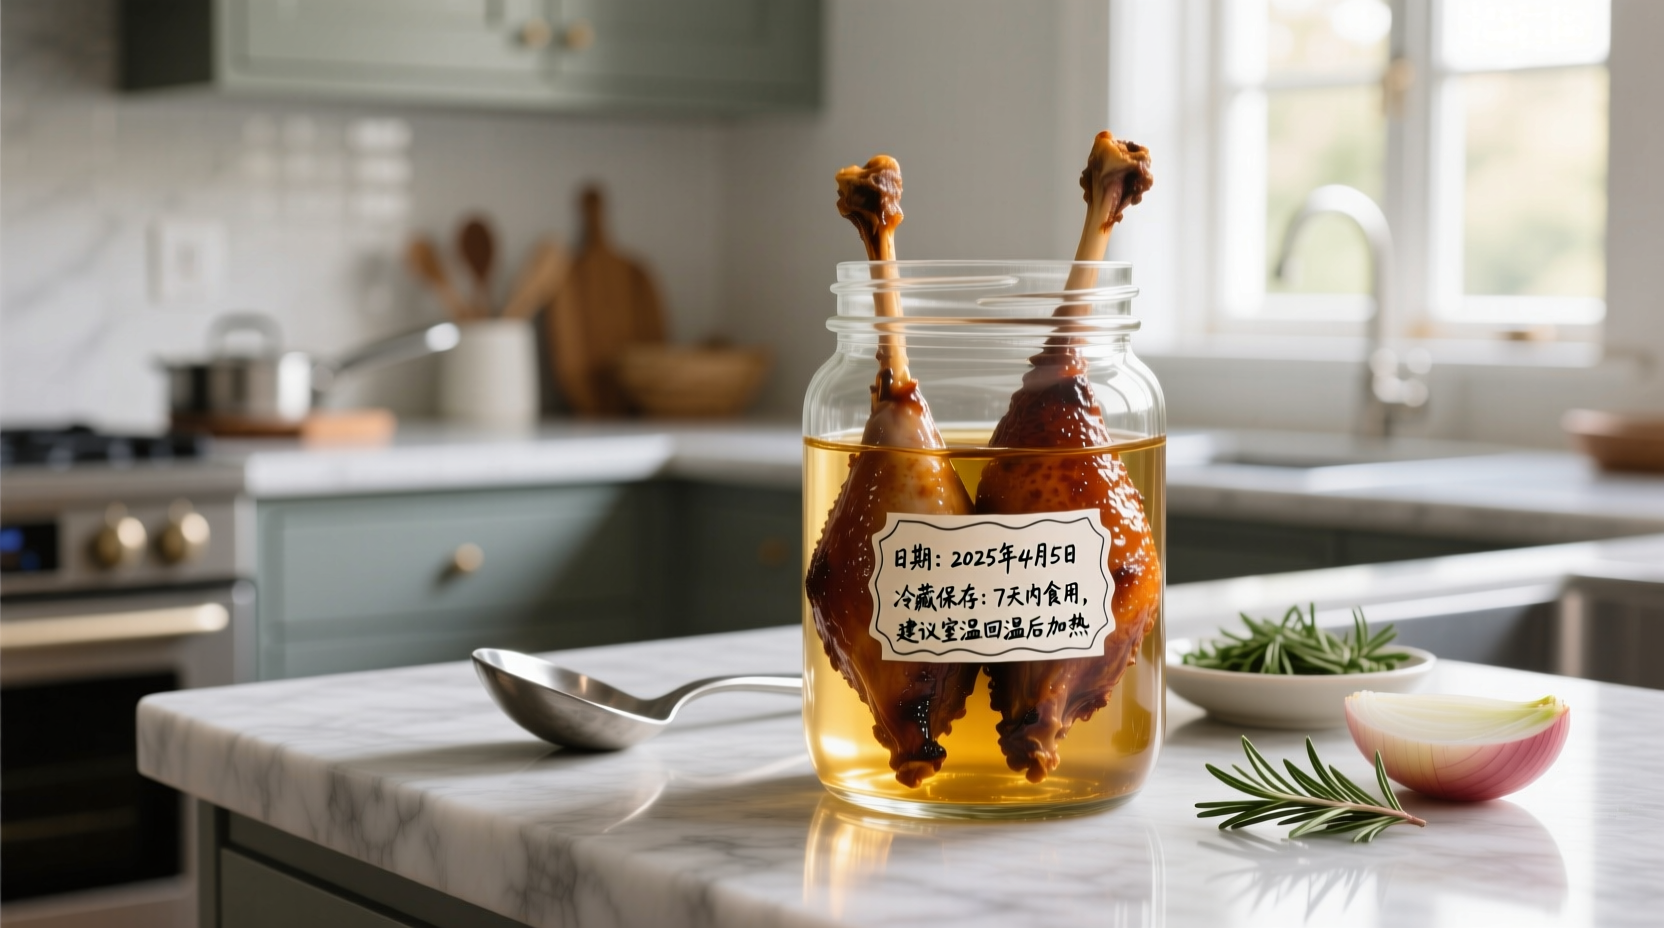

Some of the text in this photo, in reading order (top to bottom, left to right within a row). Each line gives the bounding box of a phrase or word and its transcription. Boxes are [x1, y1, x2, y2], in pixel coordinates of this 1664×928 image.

[896, 612, 1090, 644] 建议室温回温后加热
